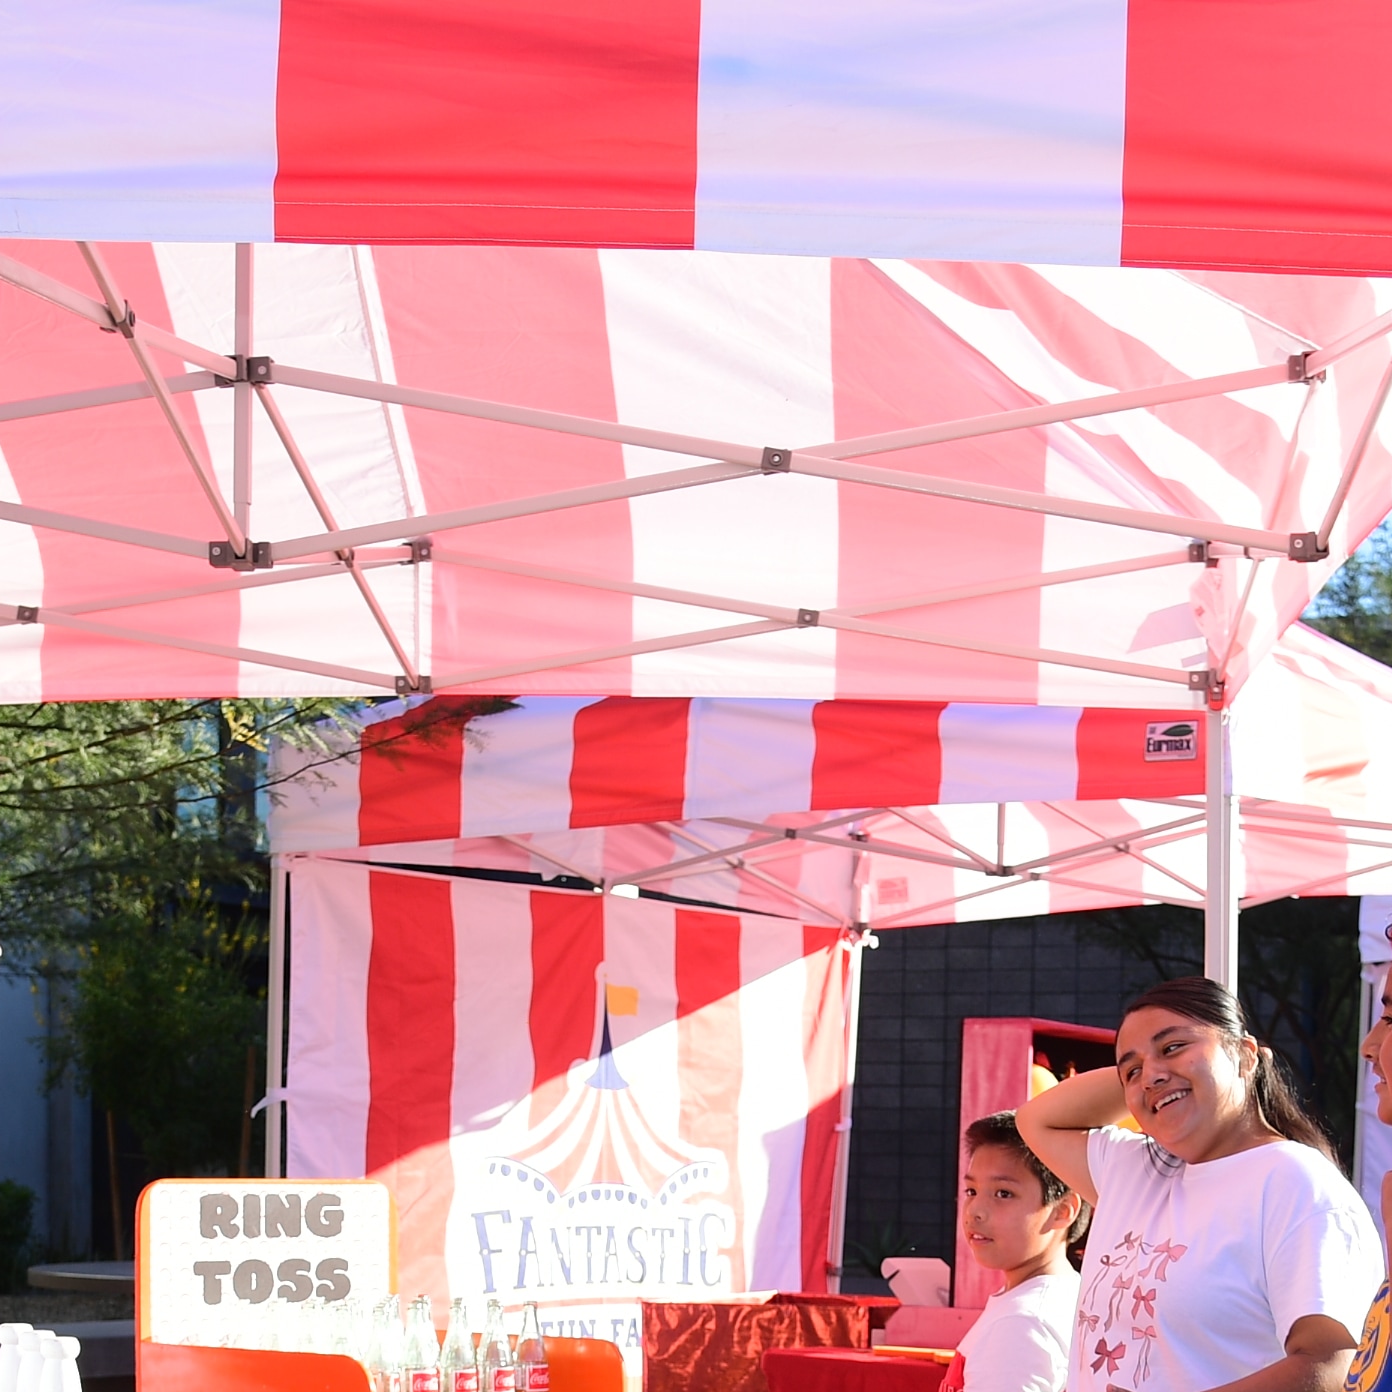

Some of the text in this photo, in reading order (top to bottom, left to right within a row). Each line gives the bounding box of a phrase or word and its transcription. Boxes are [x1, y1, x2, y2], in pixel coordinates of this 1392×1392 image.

[199, 1192, 345, 1239] RING
[471, 1209, 726, 1294] FANTASTIC
[193, 1258, 352, 1305] TOSS
[611, 1318, 643, 1347] FA
